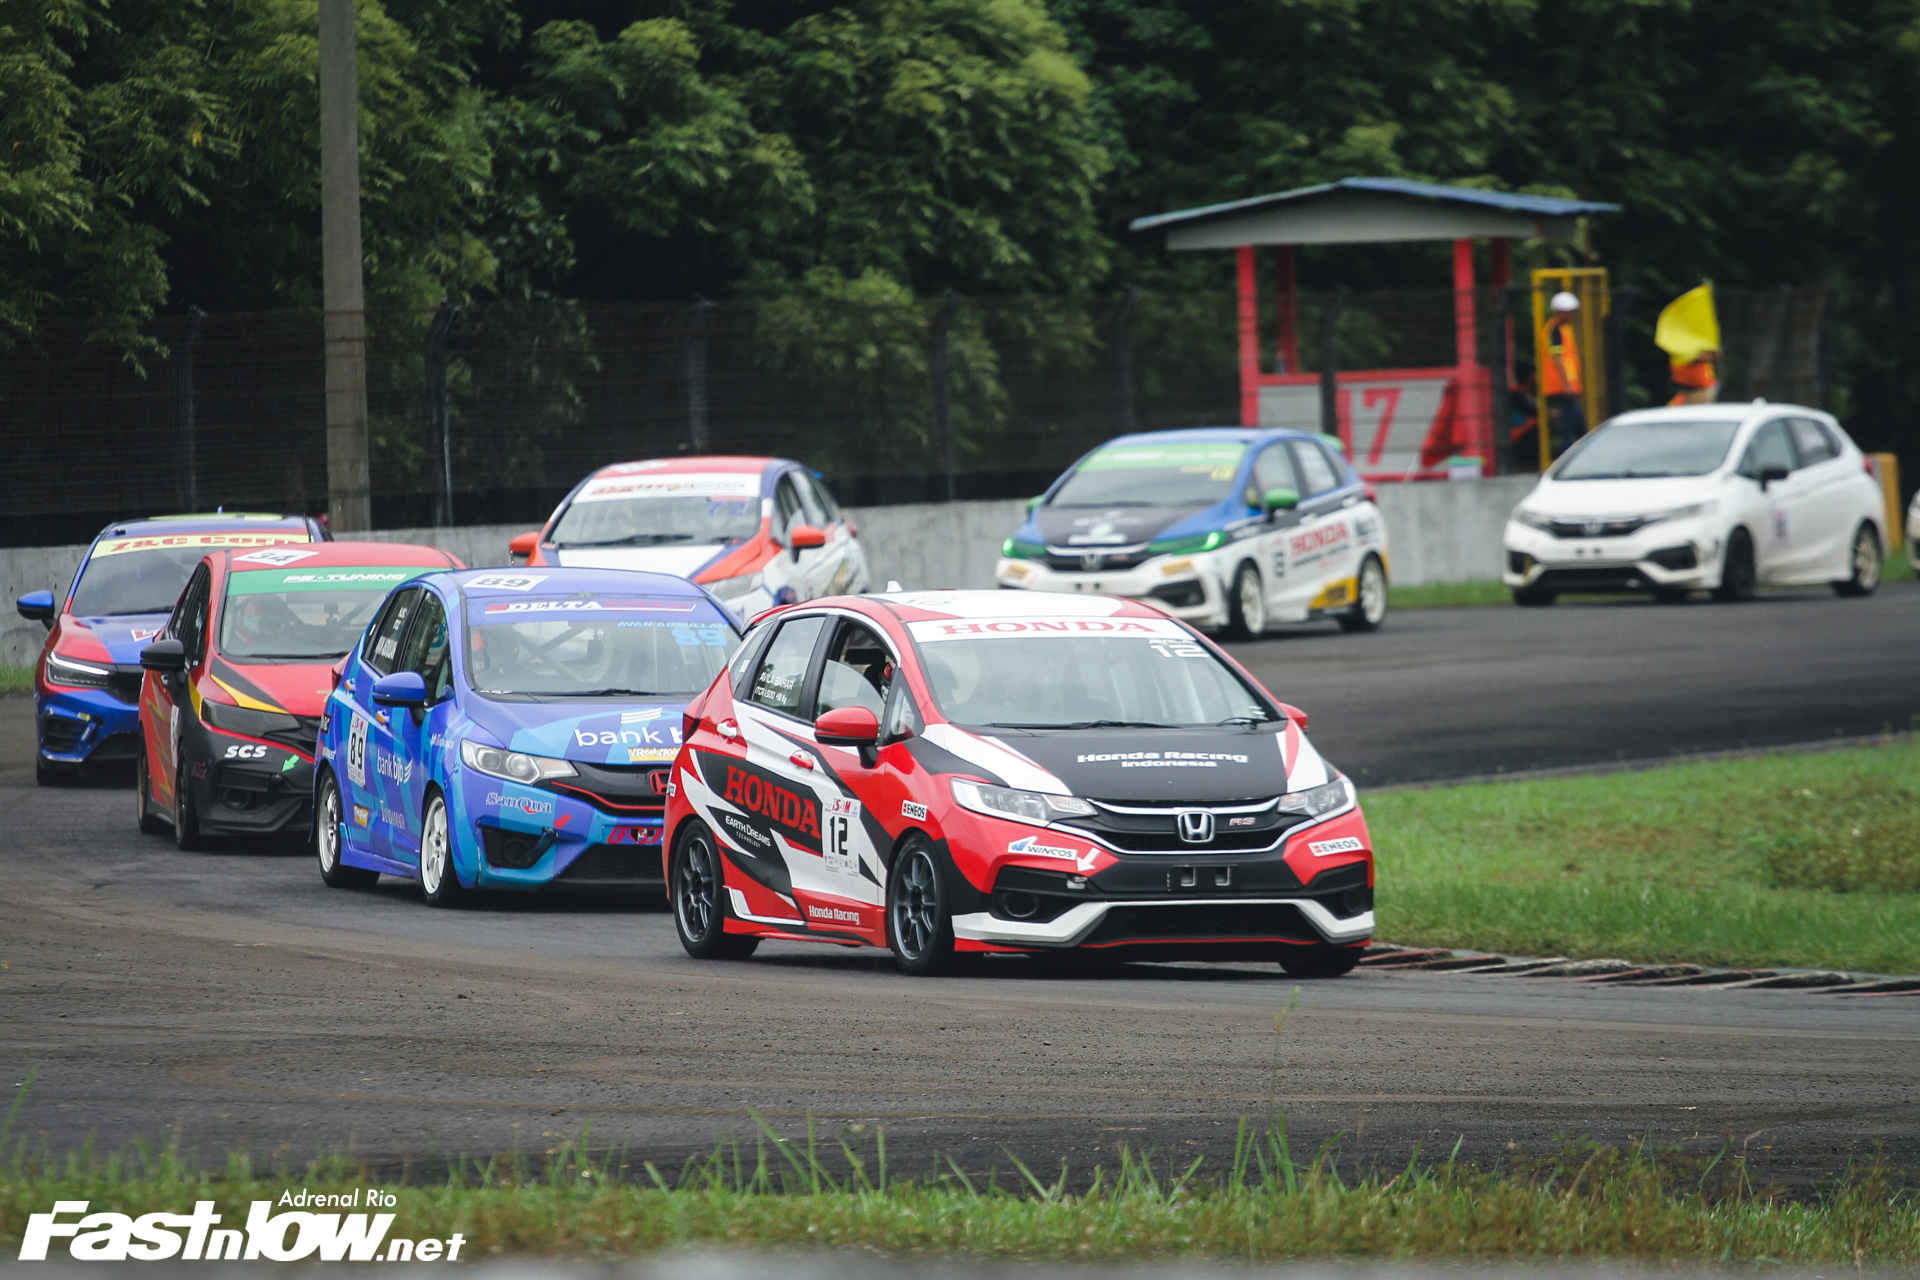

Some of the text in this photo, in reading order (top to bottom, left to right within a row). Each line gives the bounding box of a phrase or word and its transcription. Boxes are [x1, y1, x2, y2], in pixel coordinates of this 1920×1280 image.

[476, 578, 530, 587] 89
[506, 601, 602, 611] DELTA
[942, 621, 1161, 635] HONDA
[671, 629, 728, 647] 89
[1150, 644, 1209, 658] 12
[575, 728, 664, 747] bank
[224, 744, 268, 759] SCS
[350, 732, 363, 770] 89
[1077, 751, 1248, 763] Honda Racing
[377, 748, 404, 787] bank bjb
[486, 792, 552, 814] SanQua
[724, 764, 822, 840] HONDA
[906, 803, 925, 819] ENEOS
[1229, 816, 1255, 826] RS
[725, 815, 771, 847] EARTH DREAMS
[829, 815, 848, 857] 12
[1028, 845, 1073, 858] WINCOS
[1320, 839, 1359, 852] ENEOS
[808, 904, 860, 925] Honda Racing
